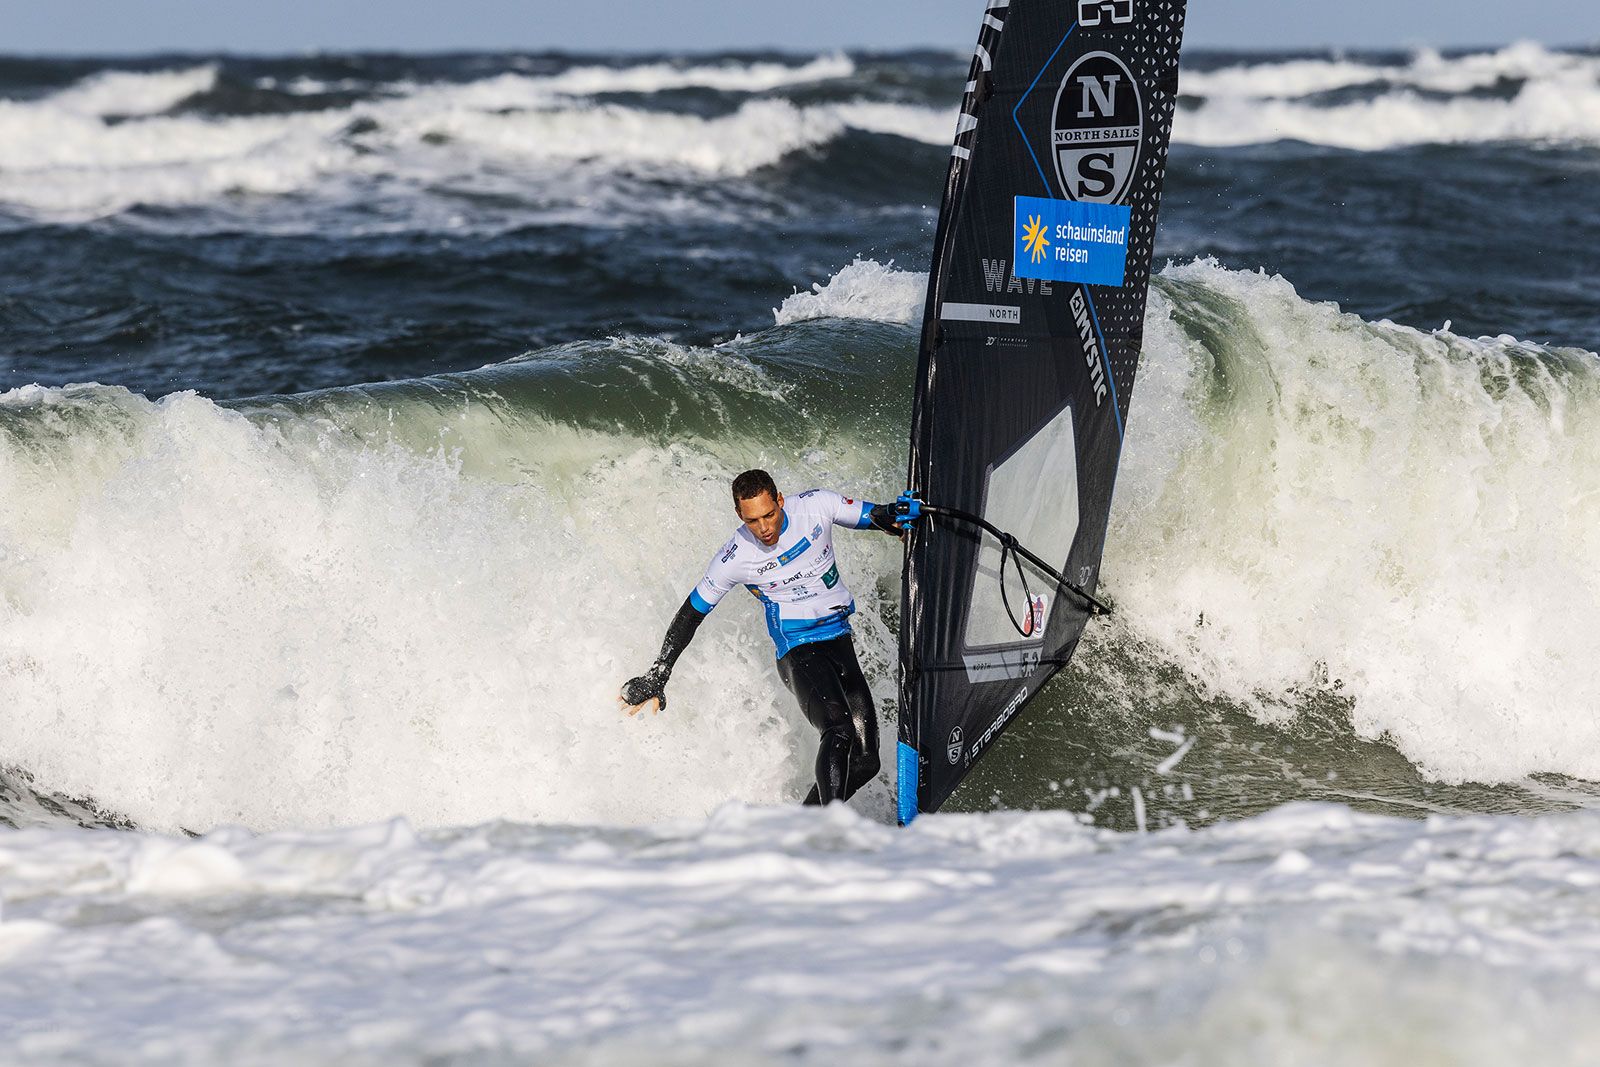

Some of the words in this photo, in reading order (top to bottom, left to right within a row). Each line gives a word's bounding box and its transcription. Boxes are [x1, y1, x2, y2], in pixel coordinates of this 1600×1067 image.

[1076, 74, 1121, 119] N
[1054, 130, 1101, 142] NORTH
[1103, 128, 1140, 140] SAILS
[1077, 153, 1116, 199] S
[1055, 221, 1125, 245] schauinsland
[1055, 243, 1089, 264] reisen
[989, 309, 1019, 320] NORTH
[1075, 312, 1107, 407] MYSTIC
[971, 686, 1028, 759] STARBOARD
[951, 730, 961, 742] N
[951, 748, 960, 760] S
